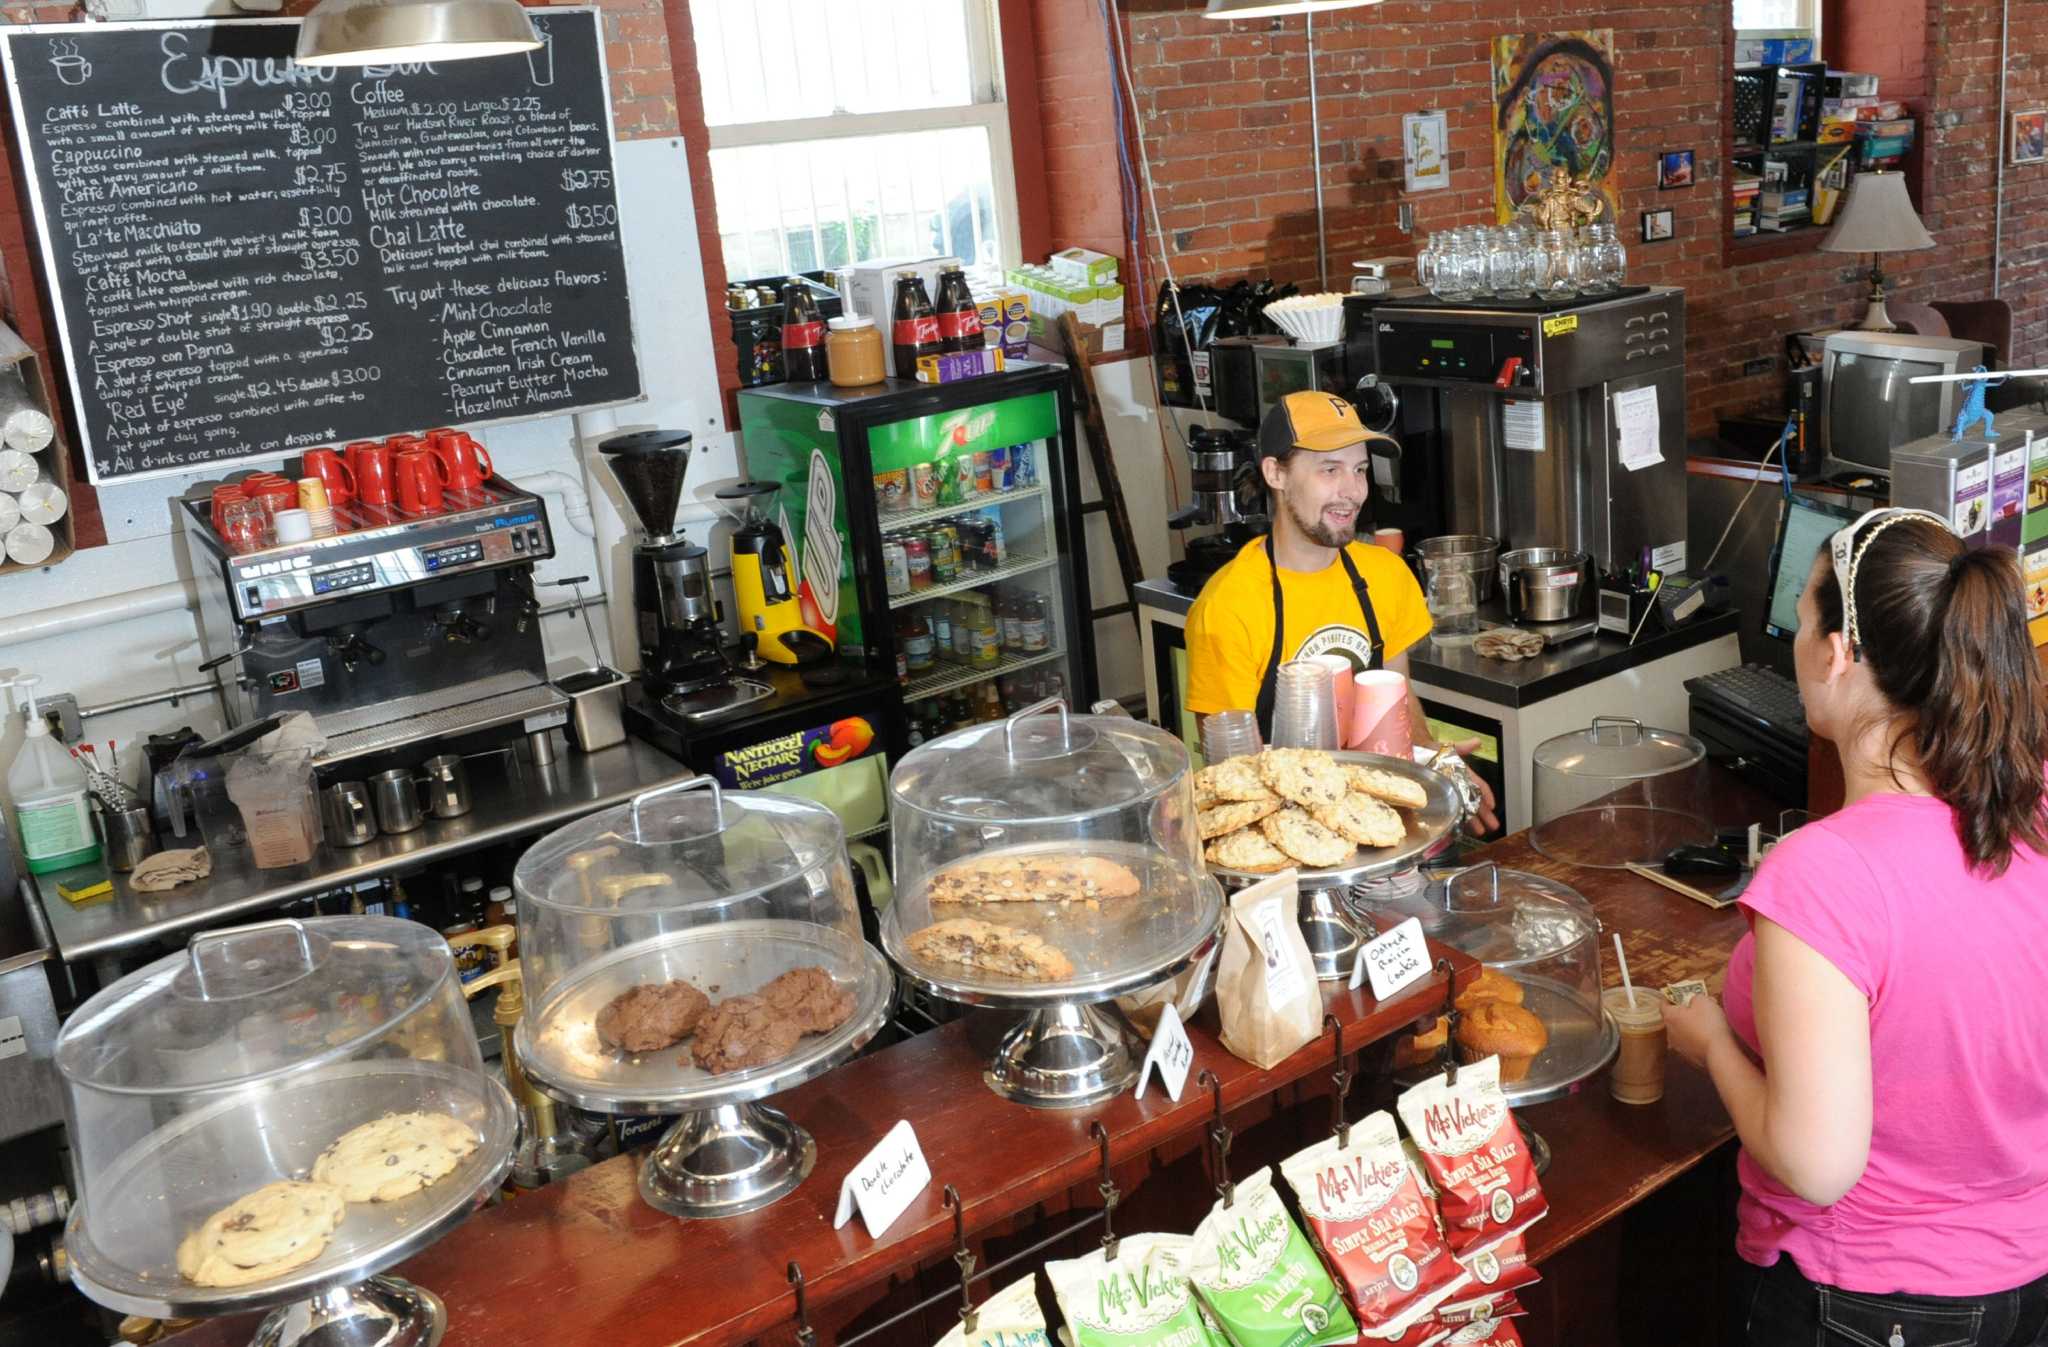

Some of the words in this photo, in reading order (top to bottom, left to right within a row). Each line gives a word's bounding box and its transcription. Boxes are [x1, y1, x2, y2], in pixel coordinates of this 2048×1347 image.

[161, 32, 337, 109] Espresso
[98, 102, 142, 117] Latte
[281, 92, 332, 110] $3.00
[350, 80, 406, 105] Coffee
[42, 122, 97, 135] Espresso
[105, 114, 164, 128] combined
[170, 111, 200, 124] with
[204, 110, 254, 123] steamed
[292, 109, 330, 122] topped
[46, 135, 73, 147] with
[130, 126, 175, 140] amount
[198, 122, 242, 135] velvety
[246, 120, 268, 131] milk
[353, 121, 379, 139] Try
[383, 122, 401, 132] our
[406, 118, 447, 132] Hudson
[448, 115, 477, 129] River
[531, 111, 557, 122] blend
[51, 145, 142, 165] Cappuccino
[289, 127, 337, 146] $3.00
[402, 146, 424, 159] with
[505, 139, 529, 151] from
[479, 151, 523, 165] rotating
[526, 149, 555, 161] choice
[52, 163, 107, 178] Espresso
[113, 157, 169, 170] combined
[174, 153, 199, 165] with
[203, 150, 247, 164] steamed
[56, 177, 86, 191] with
[104, 171, 138, 184] heavy
[143, 167, 186, 181] amount
[109, 180, 198, 199] Americano
[294, 162, 347, 187] $2.75
[60, 202, 116, 218] Espresso
[121, 196, 177, 211] combined
[179, 193, 206, 205] with
[211, 190, 232, 203] hot
[280, 184, 340, 198] essentially
[361, 186, 396, 212] Hot
[399, 181, 481, 206] Chocolate
[298, 206, 352, 228] $3.00
[370, 207, 397, 223] Milk
[399, 203, 450, 220] steamed
[451, 199, 478, 214] with
[135, 244, 163, 256] milk
[282, 229, 310, 241] milk
[311, 228, 340, 239] foam
[369, 225, 413, 249] Chai
[416, 216, 467, 243] Latte
[185, 248, 219, 262] double
[223, 245, 243, 258] shot
[380, 248, 434, 264] Delicious
[551, 233, 573, 246] with
[136, 269, 187, 285] Mocha
[300, 248, 360, 271] $3.50
[222, 275, 250, 289] with
[254, 272, 277, 286] rich
[383, 285, 418, 311] Try
[420, 281, 446, 302] out
[448, 278, 492, 298] these
[496, 275, 550, 294] delicious
[92, 318, 155, 338] Espresso
[156, 310, 193, 330] Shot
[313, 291, 368, 313] $2.25
[133, 300, 158, 312] with
[159, 293, 209, 309] whipped
[478, 295, 553, 320] Chocolate
[104, 335, 138, 354] single
[157, 326, 201, 345] double
[205, 325, 232, 339] shot
[256, 317, 301, 333] straight
[480, 320, 550, 341] Cinnamon
[511, 334, 558, 357] French
[560, 328, 607, 349] Vanilla
[95, 354, 156, 377] Espresso
[161, 349, 183, 364] con
[185, 342, 236, 361] Panna
[113, 371, 139, 388] shot
[154, 364, 204, 382] espresso
[210, 356, 250, 375] topped
[253, 352, 281, 367] with
[298, 344, 350, 366] generous
[517, 356, 546, 373] Irish
[550, 352, 594, 367] Cream
[154, 374, 203, 393] whipped
[507, 373, 557, 391] Butter
[563, 367, 609, 383] Mocha
[524, 382, 573, 404] Almond
[120, 419, 152, 440] shot
[173, 412, 223, 431] espresso
[228, 402, 281, 421] combined
[284, 396, 310, 413] with
[1328, 397, 1348, 417] P
[138, 436, 166, 454] your
[173, 432, 199, 447] day
[188, 447, 211, 463] are
[214, 441, 252, 458] made
[734, 750, 802, 780] NECTARS
[615, 1115, 662, 1141] Torani
[1445, 1097, 1497, 1136] Vickie's
[1489, 1142, 1518, 1164] SALT
[1342, 1156, 1400, 1196] Vickie's
[1231, 1213, 1286, 1259] Vickie's
[1331, 1229, 1371, 1257] SIMPLY
[1368, 1215, 1394, 1241] SEA
[1389, 1201, 1421, 1229] SALT
